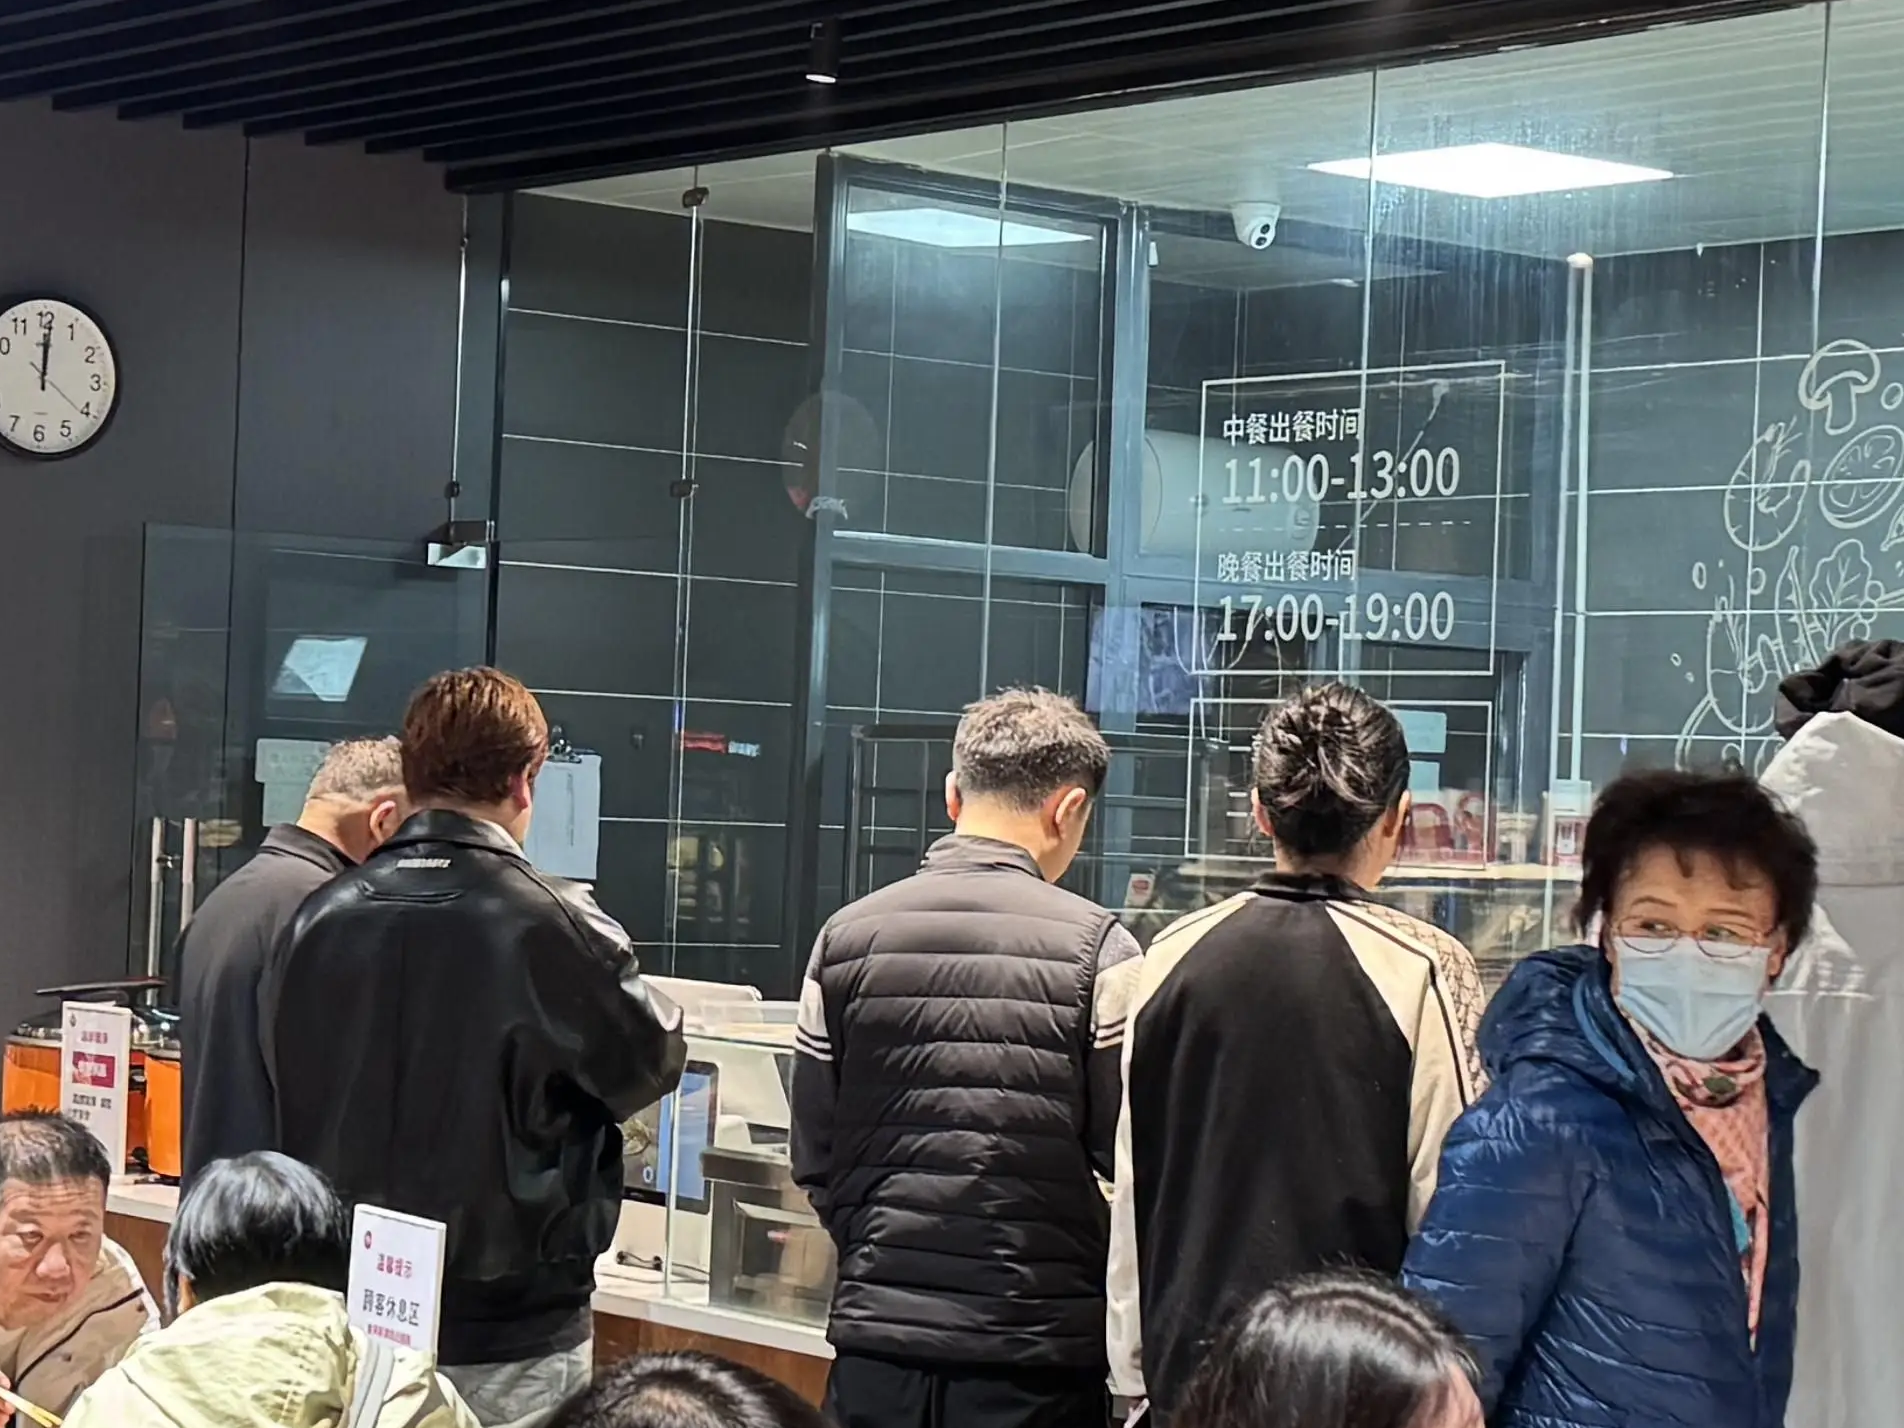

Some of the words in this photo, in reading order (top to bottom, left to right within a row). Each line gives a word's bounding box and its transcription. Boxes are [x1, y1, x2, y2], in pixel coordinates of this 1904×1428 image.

[12, 317, 27, 335] 11
[36, 311, 54, 329] 12
[67, 323, 75, 341] 1
[85, 346, 96, 364] 2
[90, 374, 101, 391] 3
[80, 402, 90, 418] 4
[9, 415, 20, 432] 7
[60, 420, 71, 437] 5
[1222, 407, 1361, 447] 中餐出餐时间
[33, 425, 45, 442] 6
[1222, 446, 1461, 505] 11:00-13:00
[1216, 549, 1356, 584] 晚餐出餐时间
[1216, 591, 1455, 642] 17:00-19:00
